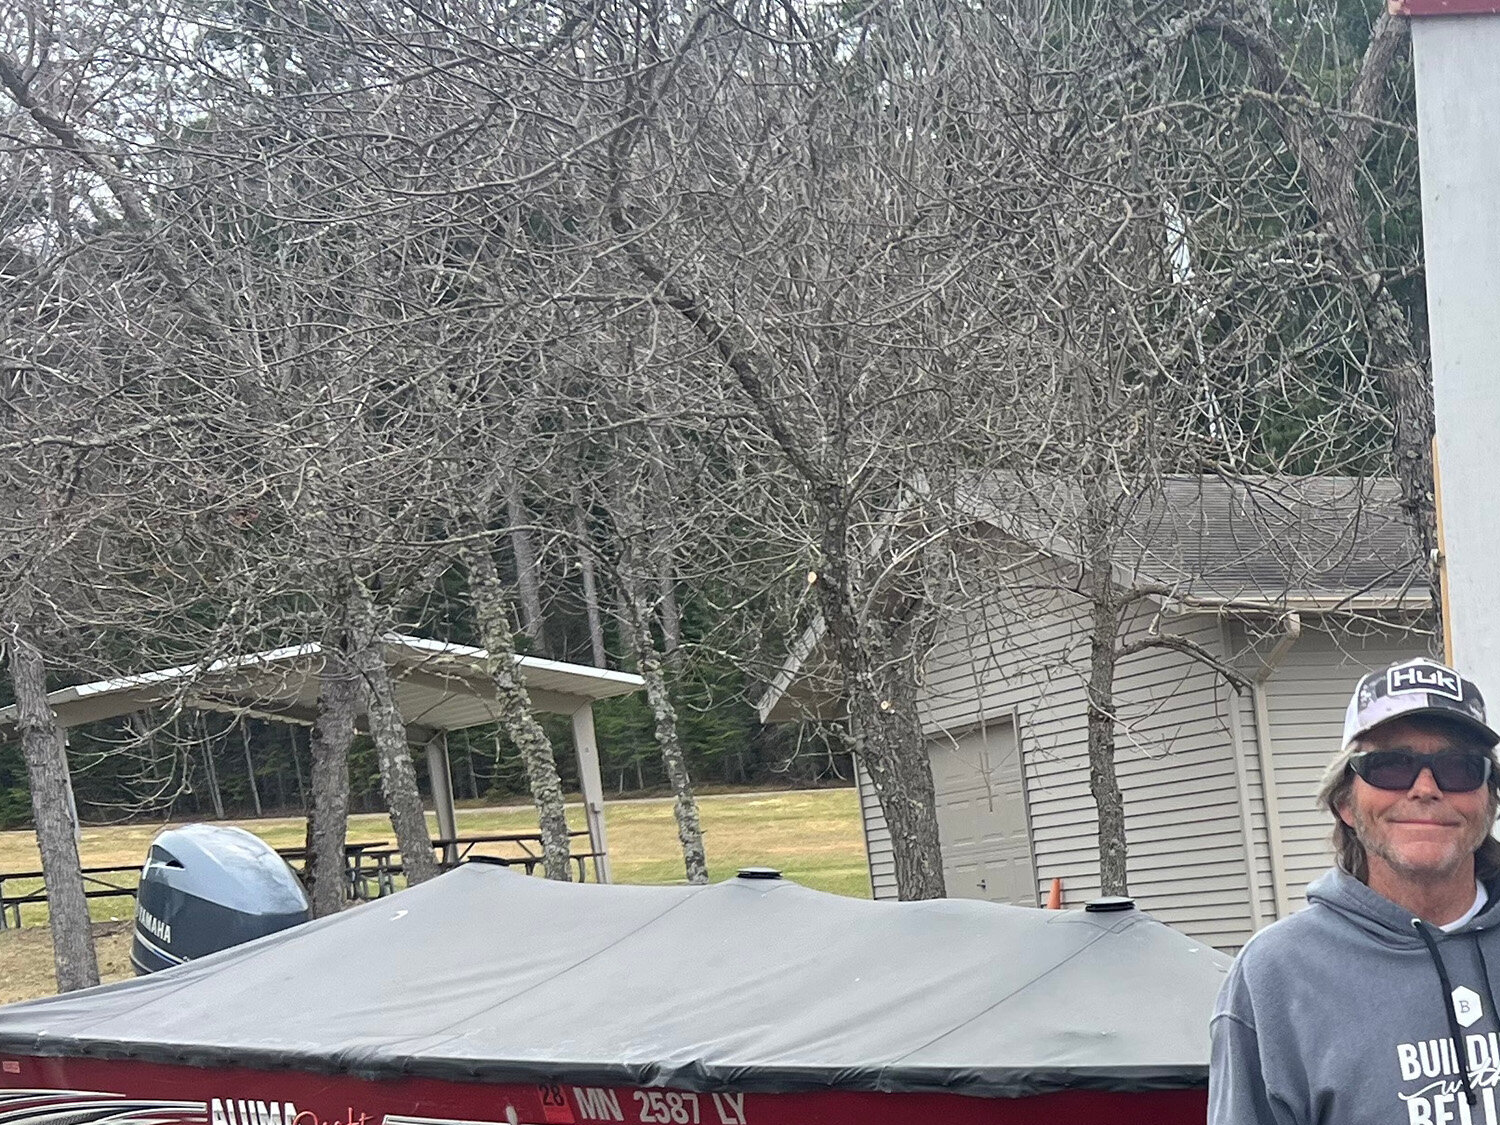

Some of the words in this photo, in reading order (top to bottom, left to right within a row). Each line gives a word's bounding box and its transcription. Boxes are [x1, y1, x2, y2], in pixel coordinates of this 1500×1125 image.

[138, 905, 171, 944] YAMAHA
[1460, 1000, 1471, 1013] B
[572, 1087, 624, 1121] MN
[633, 1090, 700, 1124] 2587
[712, 1092, 747, 1125] LY
